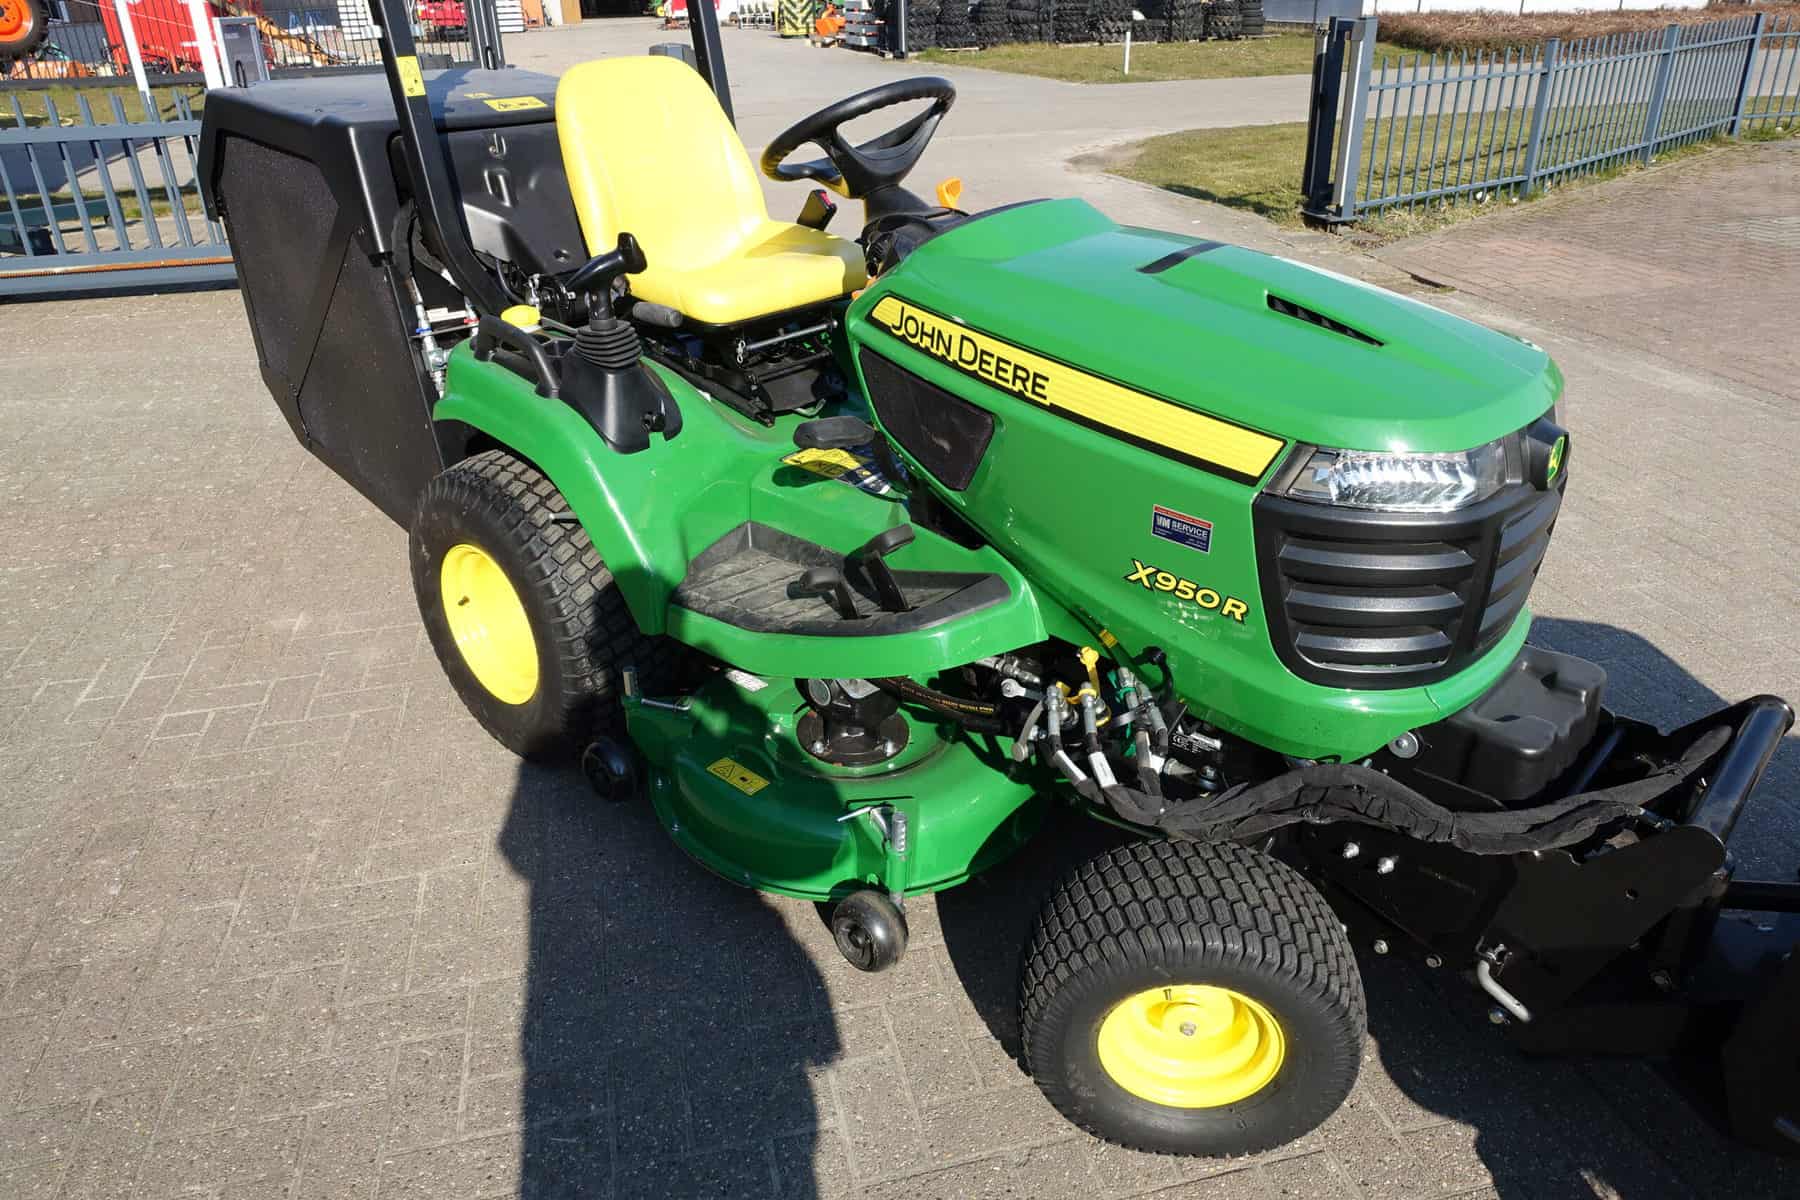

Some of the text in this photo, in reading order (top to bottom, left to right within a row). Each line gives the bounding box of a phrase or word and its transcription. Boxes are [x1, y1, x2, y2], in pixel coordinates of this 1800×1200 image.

[891, 305, 1050, 401] JOHN DEERE
[1171, 520, 1208, 538] SERVICE
